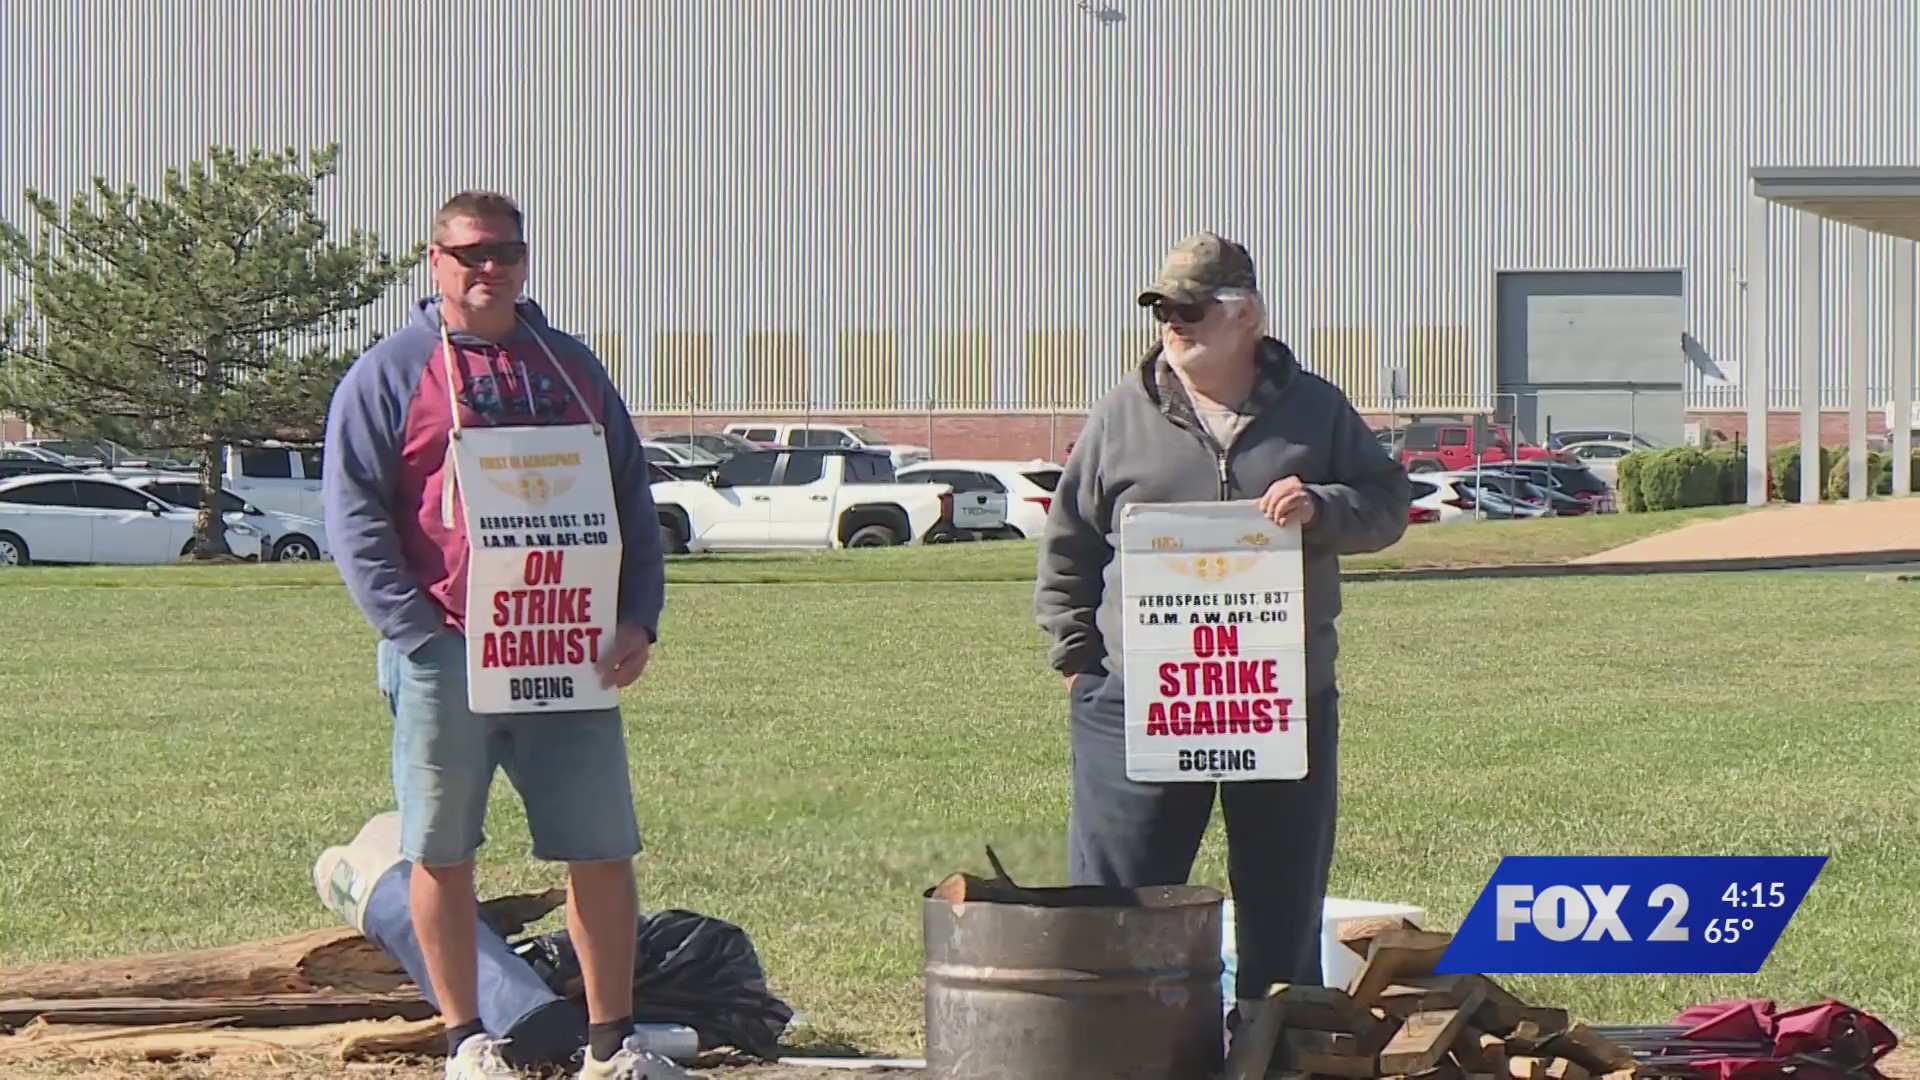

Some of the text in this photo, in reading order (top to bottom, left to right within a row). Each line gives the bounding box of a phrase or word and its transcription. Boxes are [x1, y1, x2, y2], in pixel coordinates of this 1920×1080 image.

[480, 513, 605, 529] AEROSPACE DIST. 837
[483, 535, 520, 547] I.A.M.
[524, 550, 564, 586] ON
[493, 588, 592, 627] STRIKE
[1139, 591, 1289, 607] AEROSPACE DIST. 837
[1227, 610, 1288, 623] AFL-CIO
[482, 628, 602, 668] AGAINST
[1193, 625, 1239, 659] ON
[510, 676, 574, 700] BOEING
[1158, 659, 1279, 697] STRIKE
[1146, 698, 1293, 736] AGAINST
[1178, 748, 1256, 772] BOEING
